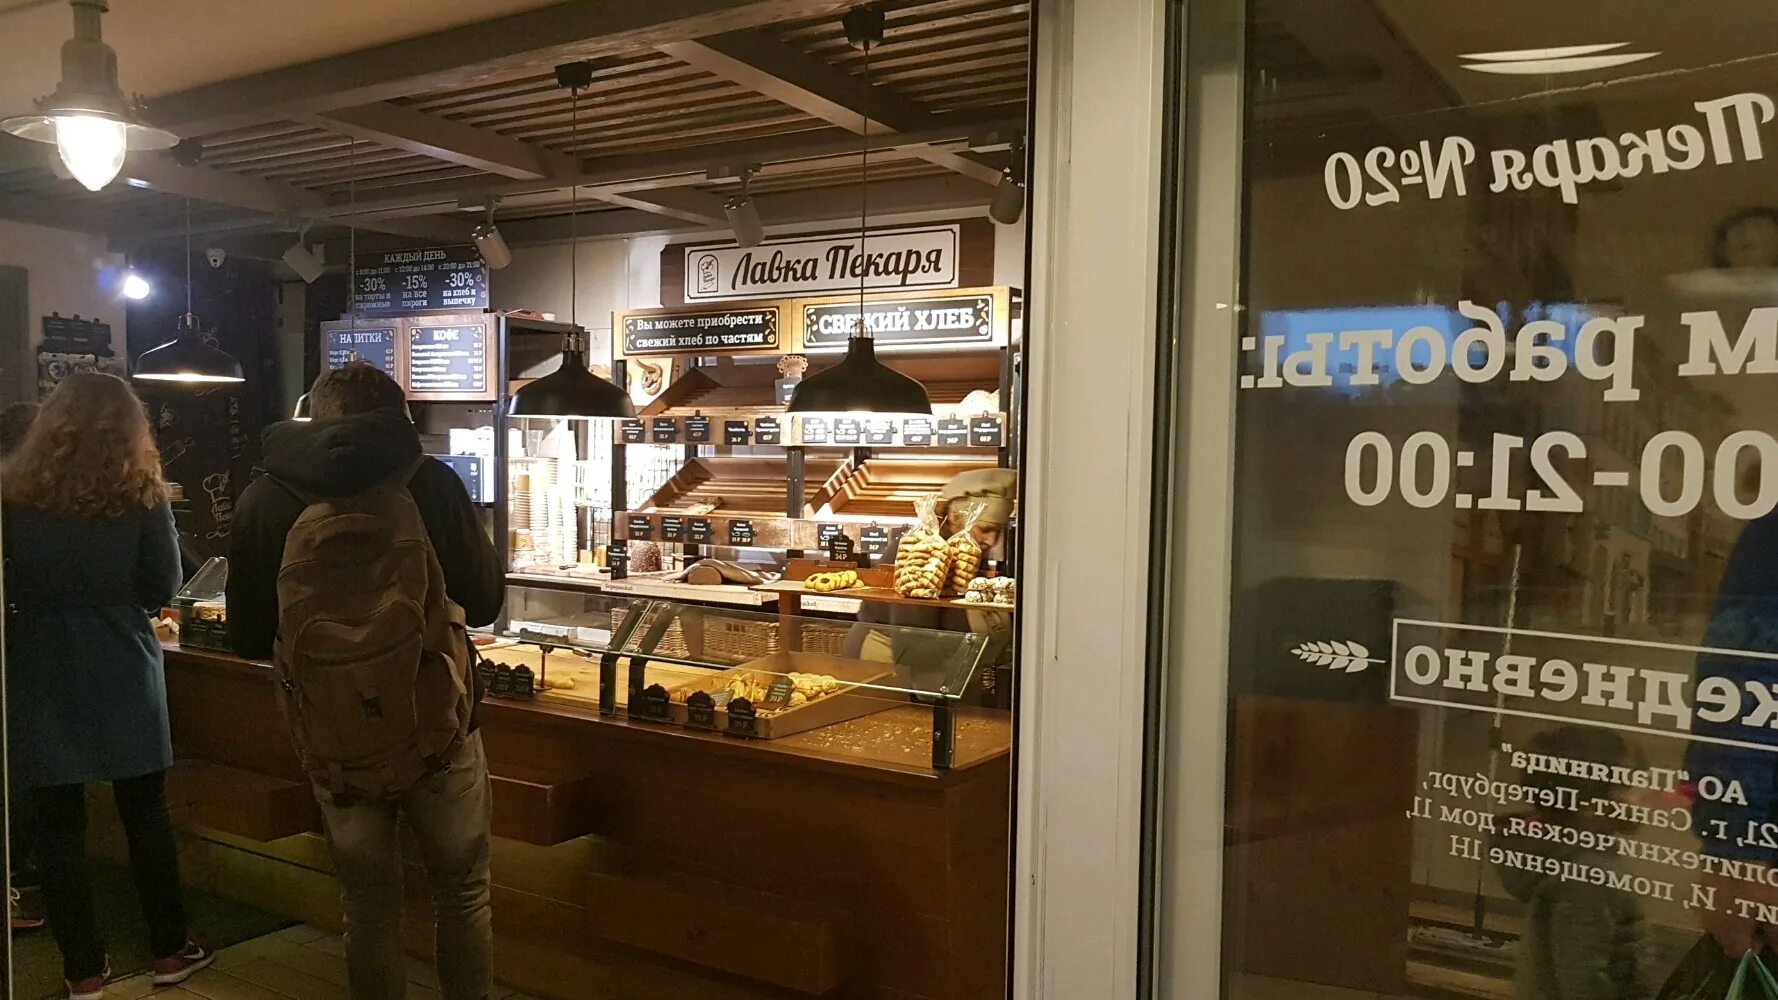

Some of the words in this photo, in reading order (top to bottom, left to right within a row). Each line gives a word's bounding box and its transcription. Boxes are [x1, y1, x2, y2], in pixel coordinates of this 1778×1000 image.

[384, 251, 422, 263] КАЖДЫЙ
[423, 250, 447, 262] ДЕНЬ
[731, 250, 819, 291] Лавка
[825, 244, 943, 286] Пекаря
[360, 277, 386, 291] -30%
[401, 274, 428, 289] -15%
[445, 271, 475, 287] -30%
[414, 290, 428, 298] все
[452, 287, 470, 296] хлеб
[402, 300, 428, 308] пироги
[443, 297, 476, 305] выпечку
[636, 319, 653, 331] Вы
[654, 319, 695, 330] можете
[697, 314, 763, 329] приобрести
[818, 306, 911, 334] СВЕЖИЙ
[913, 307, 975, 331] ХЛЕБ
[432, 328, 460, 341] КОФЕ
[636, 335, 677, 348] свежий
[678, 334, 703, 346] хлеб
[704, 336, 719, 345] по
[721, 332, 763, 344] частям
